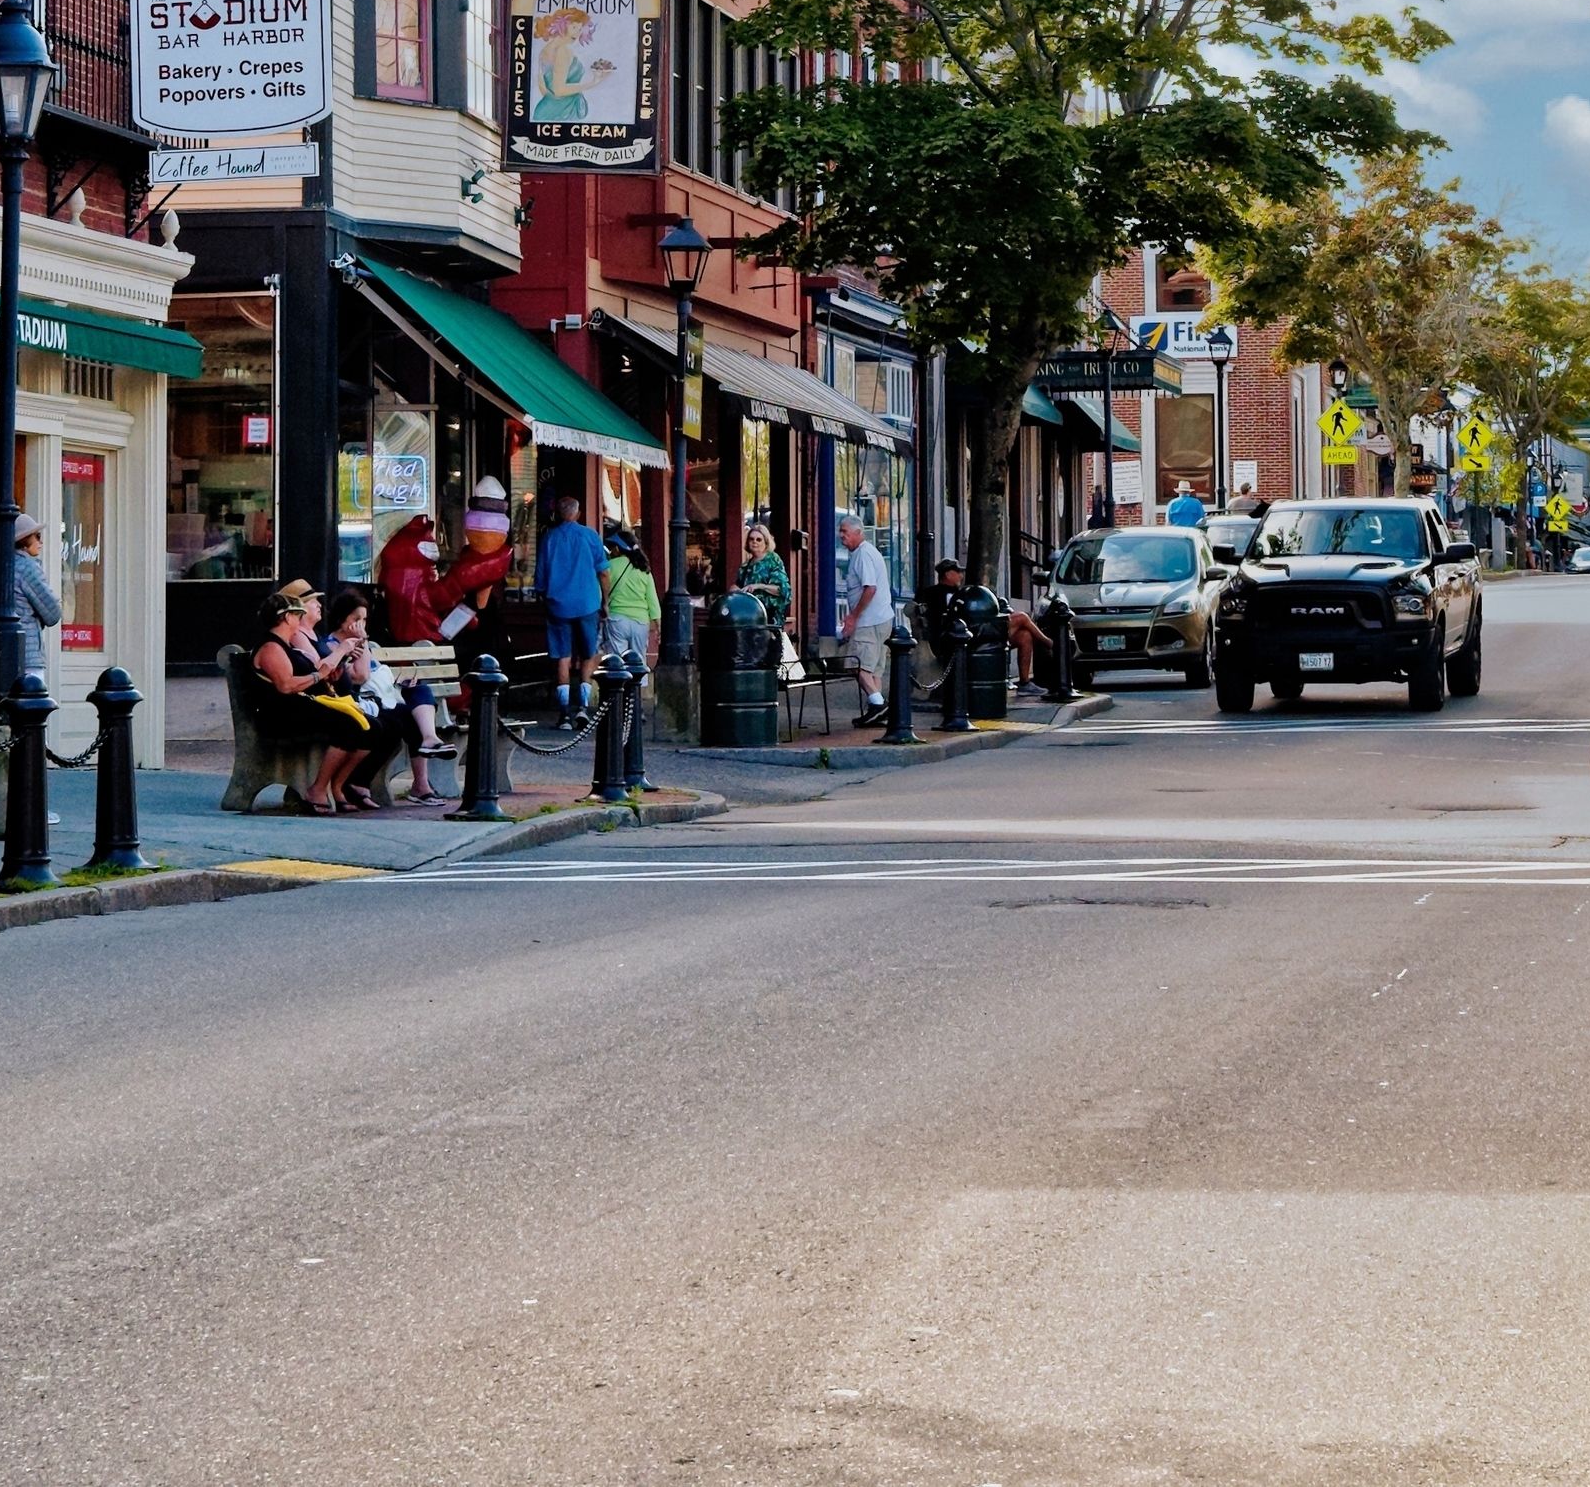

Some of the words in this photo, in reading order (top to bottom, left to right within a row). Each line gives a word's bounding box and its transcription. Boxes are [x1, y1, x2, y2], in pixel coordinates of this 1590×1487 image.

[158, 34, 200, 49] BAR
[223, 28, 304, 46] HARBOR
[159, 64, 221, 81] Bakery
[239, 60, 304, 78] Crepes
[513, 18, 526, 117] CANDIES
[641, 20, 653, 106] COFFEE
[159, 86, 245, 105] Popovers
[263, 81, 306, 97] Gifts
[537, 124, 561, 138] ICE
[570, 124, 627, 139] CREAM
[526, 143, 559, 159] MADE
[564, 145, 599, 161] FRESH
[604, 147, 637, 162] DAILY
[158, 155, 209, 177] Coffee
[215, 150, 265, 176] Hound
[17, 314, 66, 350] TADIUM
[1084, 362, 1117, 376] TRUT
[1327, 451, 1353, 459] AHEAD
[375, 459, 417, 477] ried
[373, 481, 422, 504] ough
[1291, 607, 1345, 615] RAM
